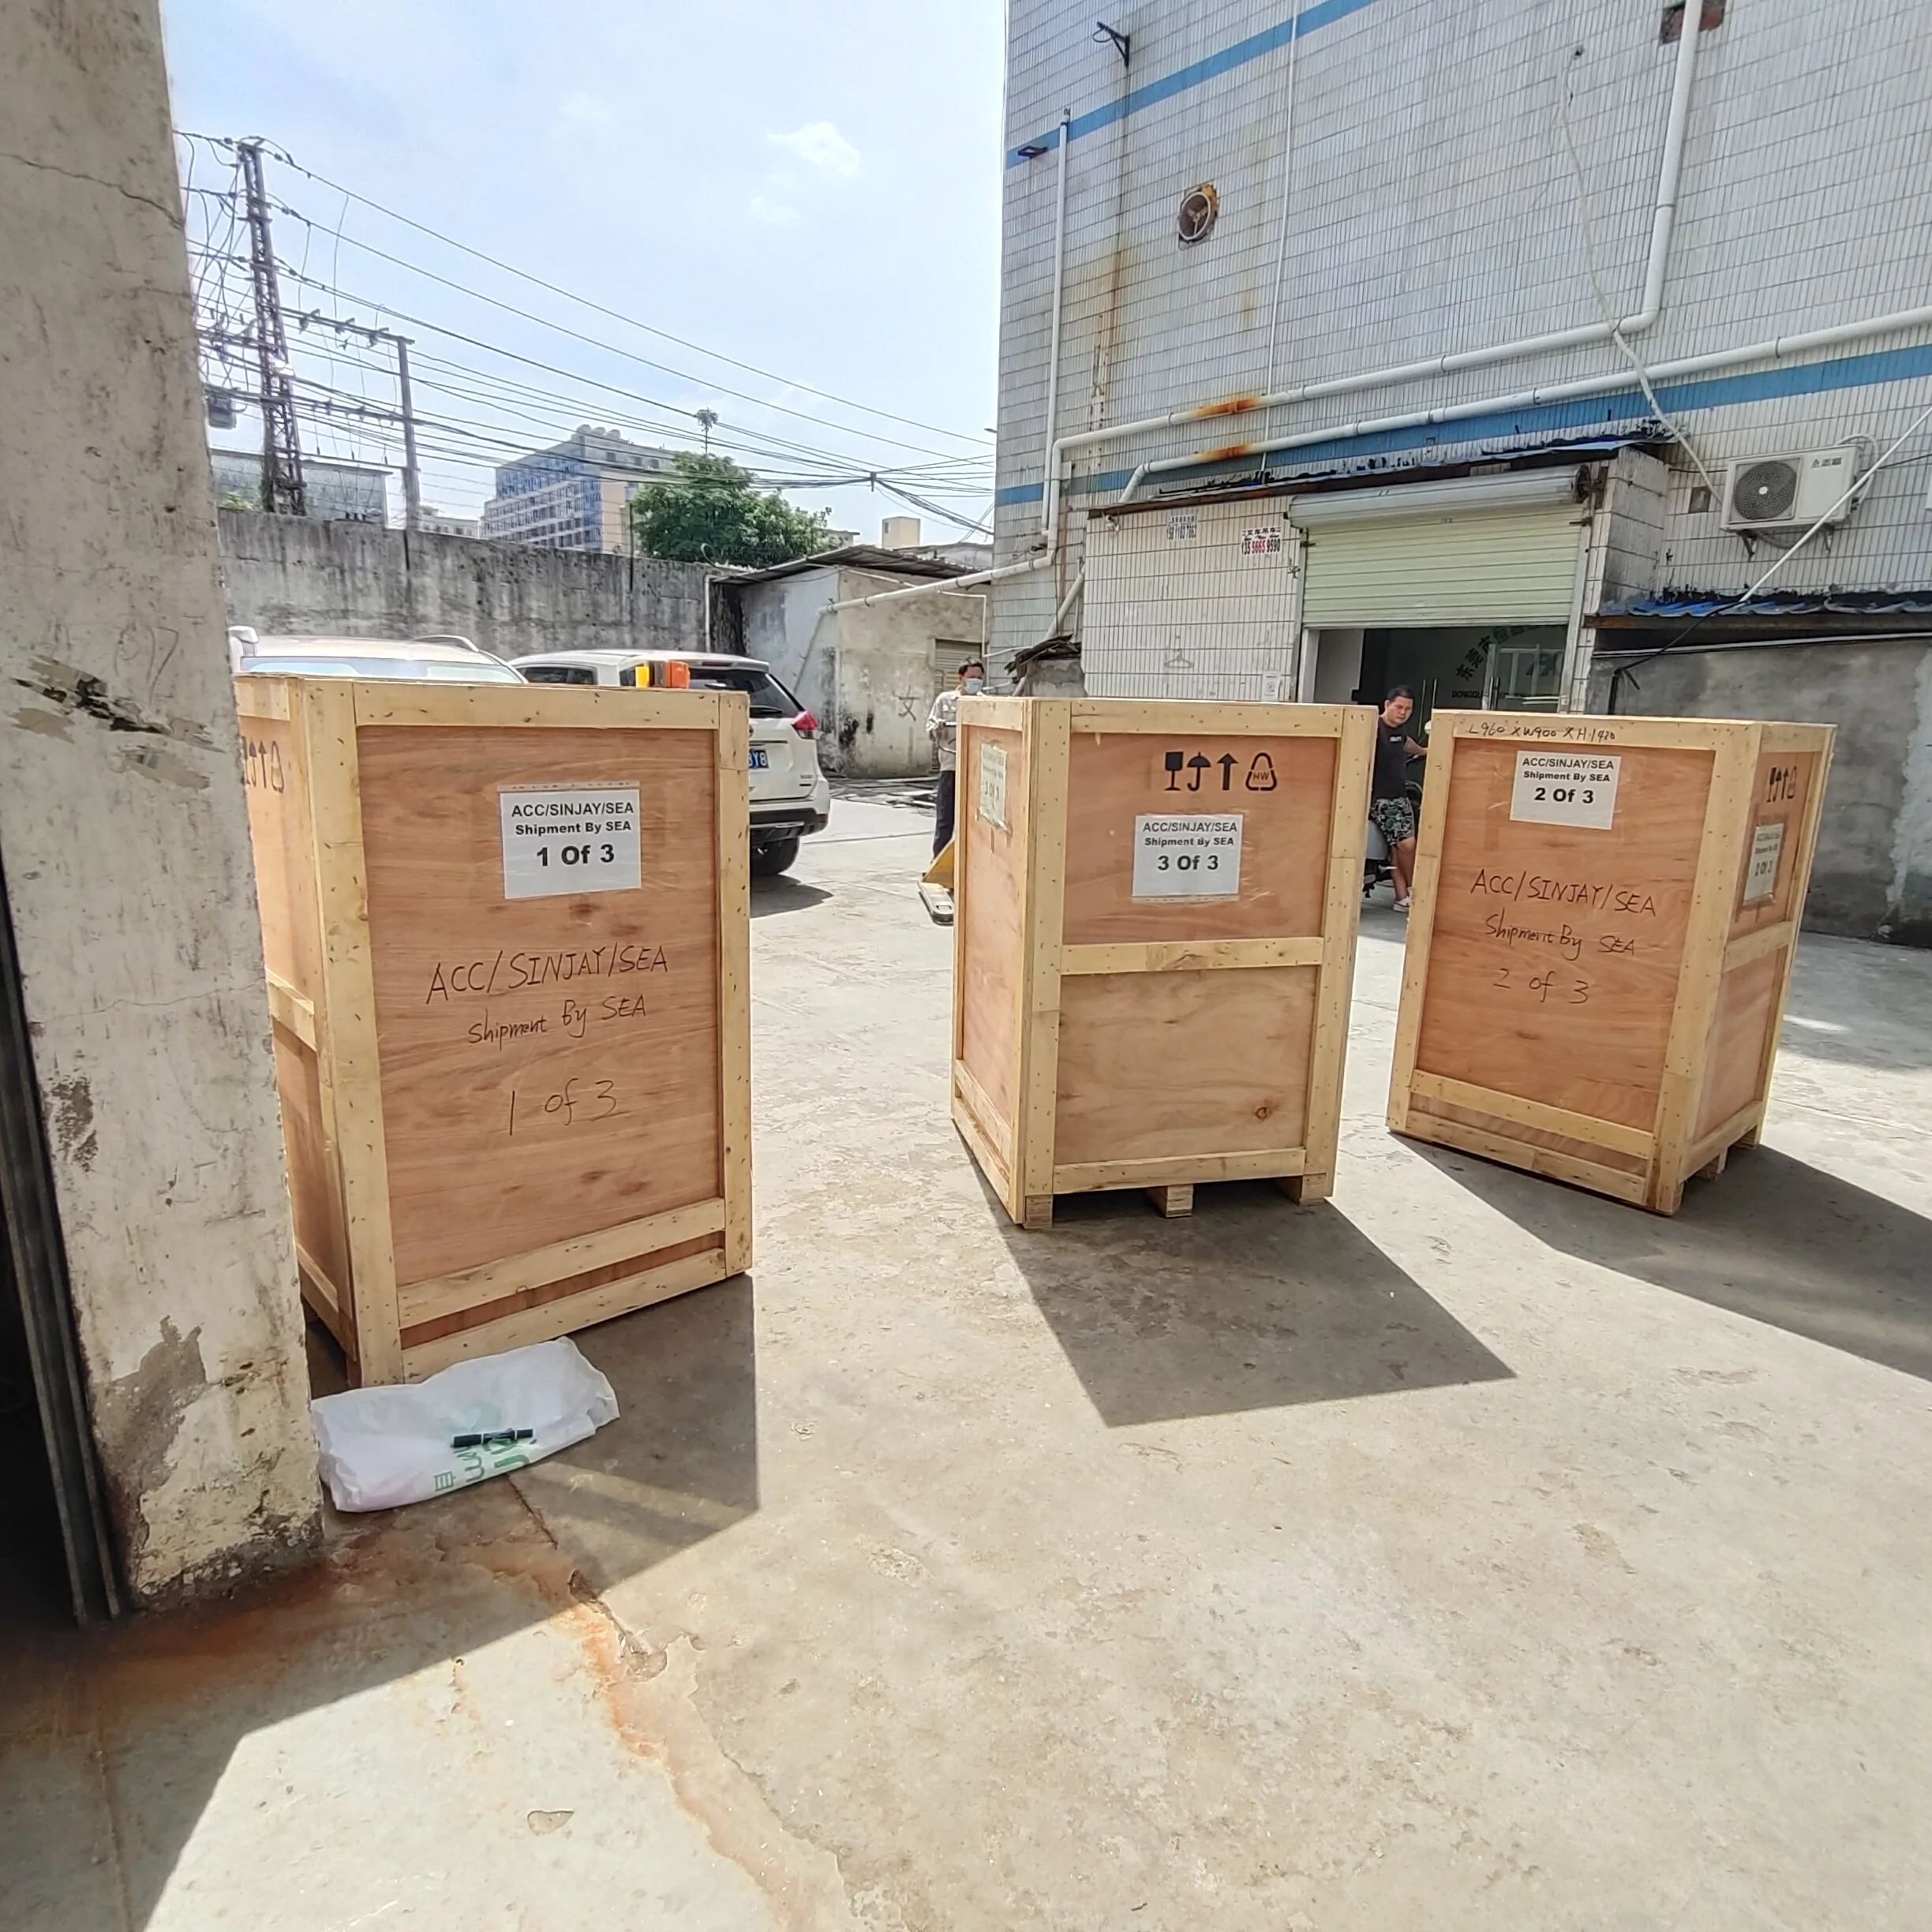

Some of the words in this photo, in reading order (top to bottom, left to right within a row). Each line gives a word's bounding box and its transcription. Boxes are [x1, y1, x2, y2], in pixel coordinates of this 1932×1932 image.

[1241, 541, 1251, 555] 135
[1468, 722, 1505, 736] L960
[1522, 757, 1615, 770] ACC/SINJAY/SEA
[1523, 770, 1571, 781] Shipment
[1573, 773, 1586, 783] By
[1589, 773, 1611, 782] SEA
[1533, 787, 1546, 801] 2
[1552, 788, 1576, 803] Of
[1582, 789, 1594, 804] 3
[511, 802, 634, 818] ACC/SINJAY/SEA
[515, 822, 581, 837] Shipment
[585, 822, 602, 834] By
[605, 821, 631, 831] SEA
[1143, 822, 1237, 833] ACC/SINJAY/SEA
[1144, 837, 1194, 848] Shipment
[1197, 838, 1210, 848] By
[536, 847, 549, 867] 1
[561, 844, 591, 865] Of
[600, 844, 615, 863] 3
[1157, 855, 1170, 871] 3
[1177, 855, 1201, 871] Of
[1207, 855, 1219, 870] 3
[1470, 868, 1657, 917] ACC/SINJAY/SEA
[1485, 908, 1554, 945] Shipment
[1559, 924, 1582, 961] By
[1597, 934, 1635, 957] SEA
[426, 942, 668, 1004] ACC/SINJAY/SEA
[1493, 968, 1512, 989] 2
[1529, 971, 1556, 1003] of
[1568, 979, 1589, 1004] 3
[562, 999, 587, 1039] By
[602, 994, 646, 1020] SEA
[509, 1090, 515, 1136] 1
[545, 1078, 579, 1126] of
[592, 1080, 617, 1121] 3
